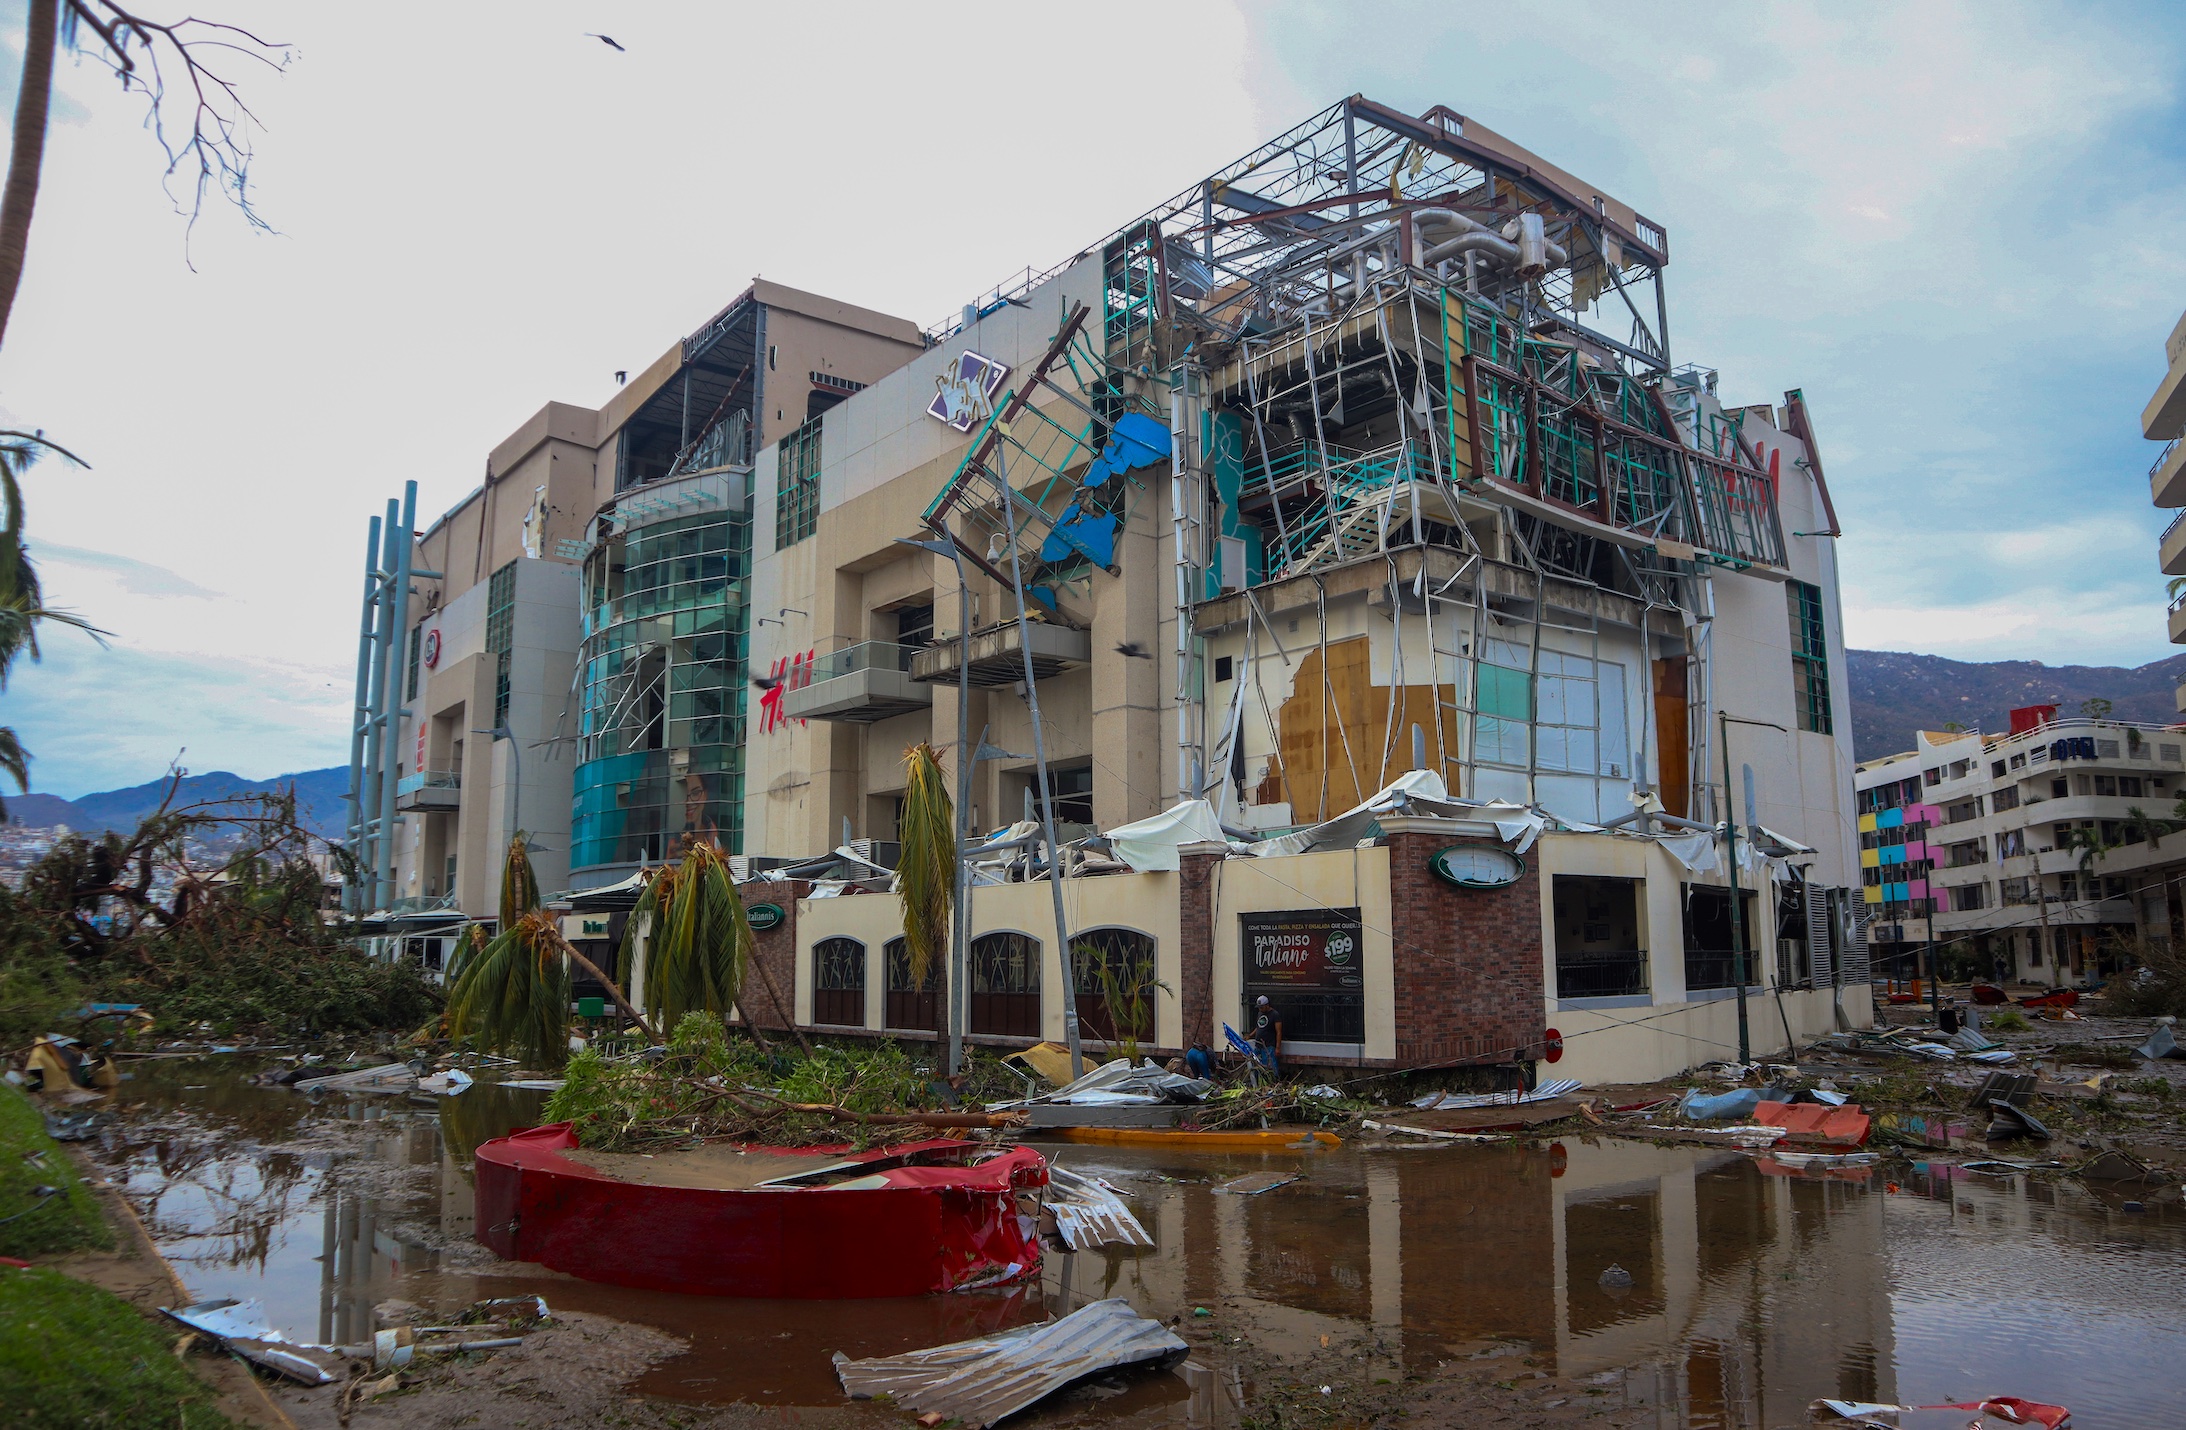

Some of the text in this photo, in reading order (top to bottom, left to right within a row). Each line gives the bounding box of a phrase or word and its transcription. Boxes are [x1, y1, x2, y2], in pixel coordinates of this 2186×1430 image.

[1254, 935, 1310, 947] PARADISO
[1323, 936, 1354, 958] $199
[1255, 940, 1309, 968] Italiano
